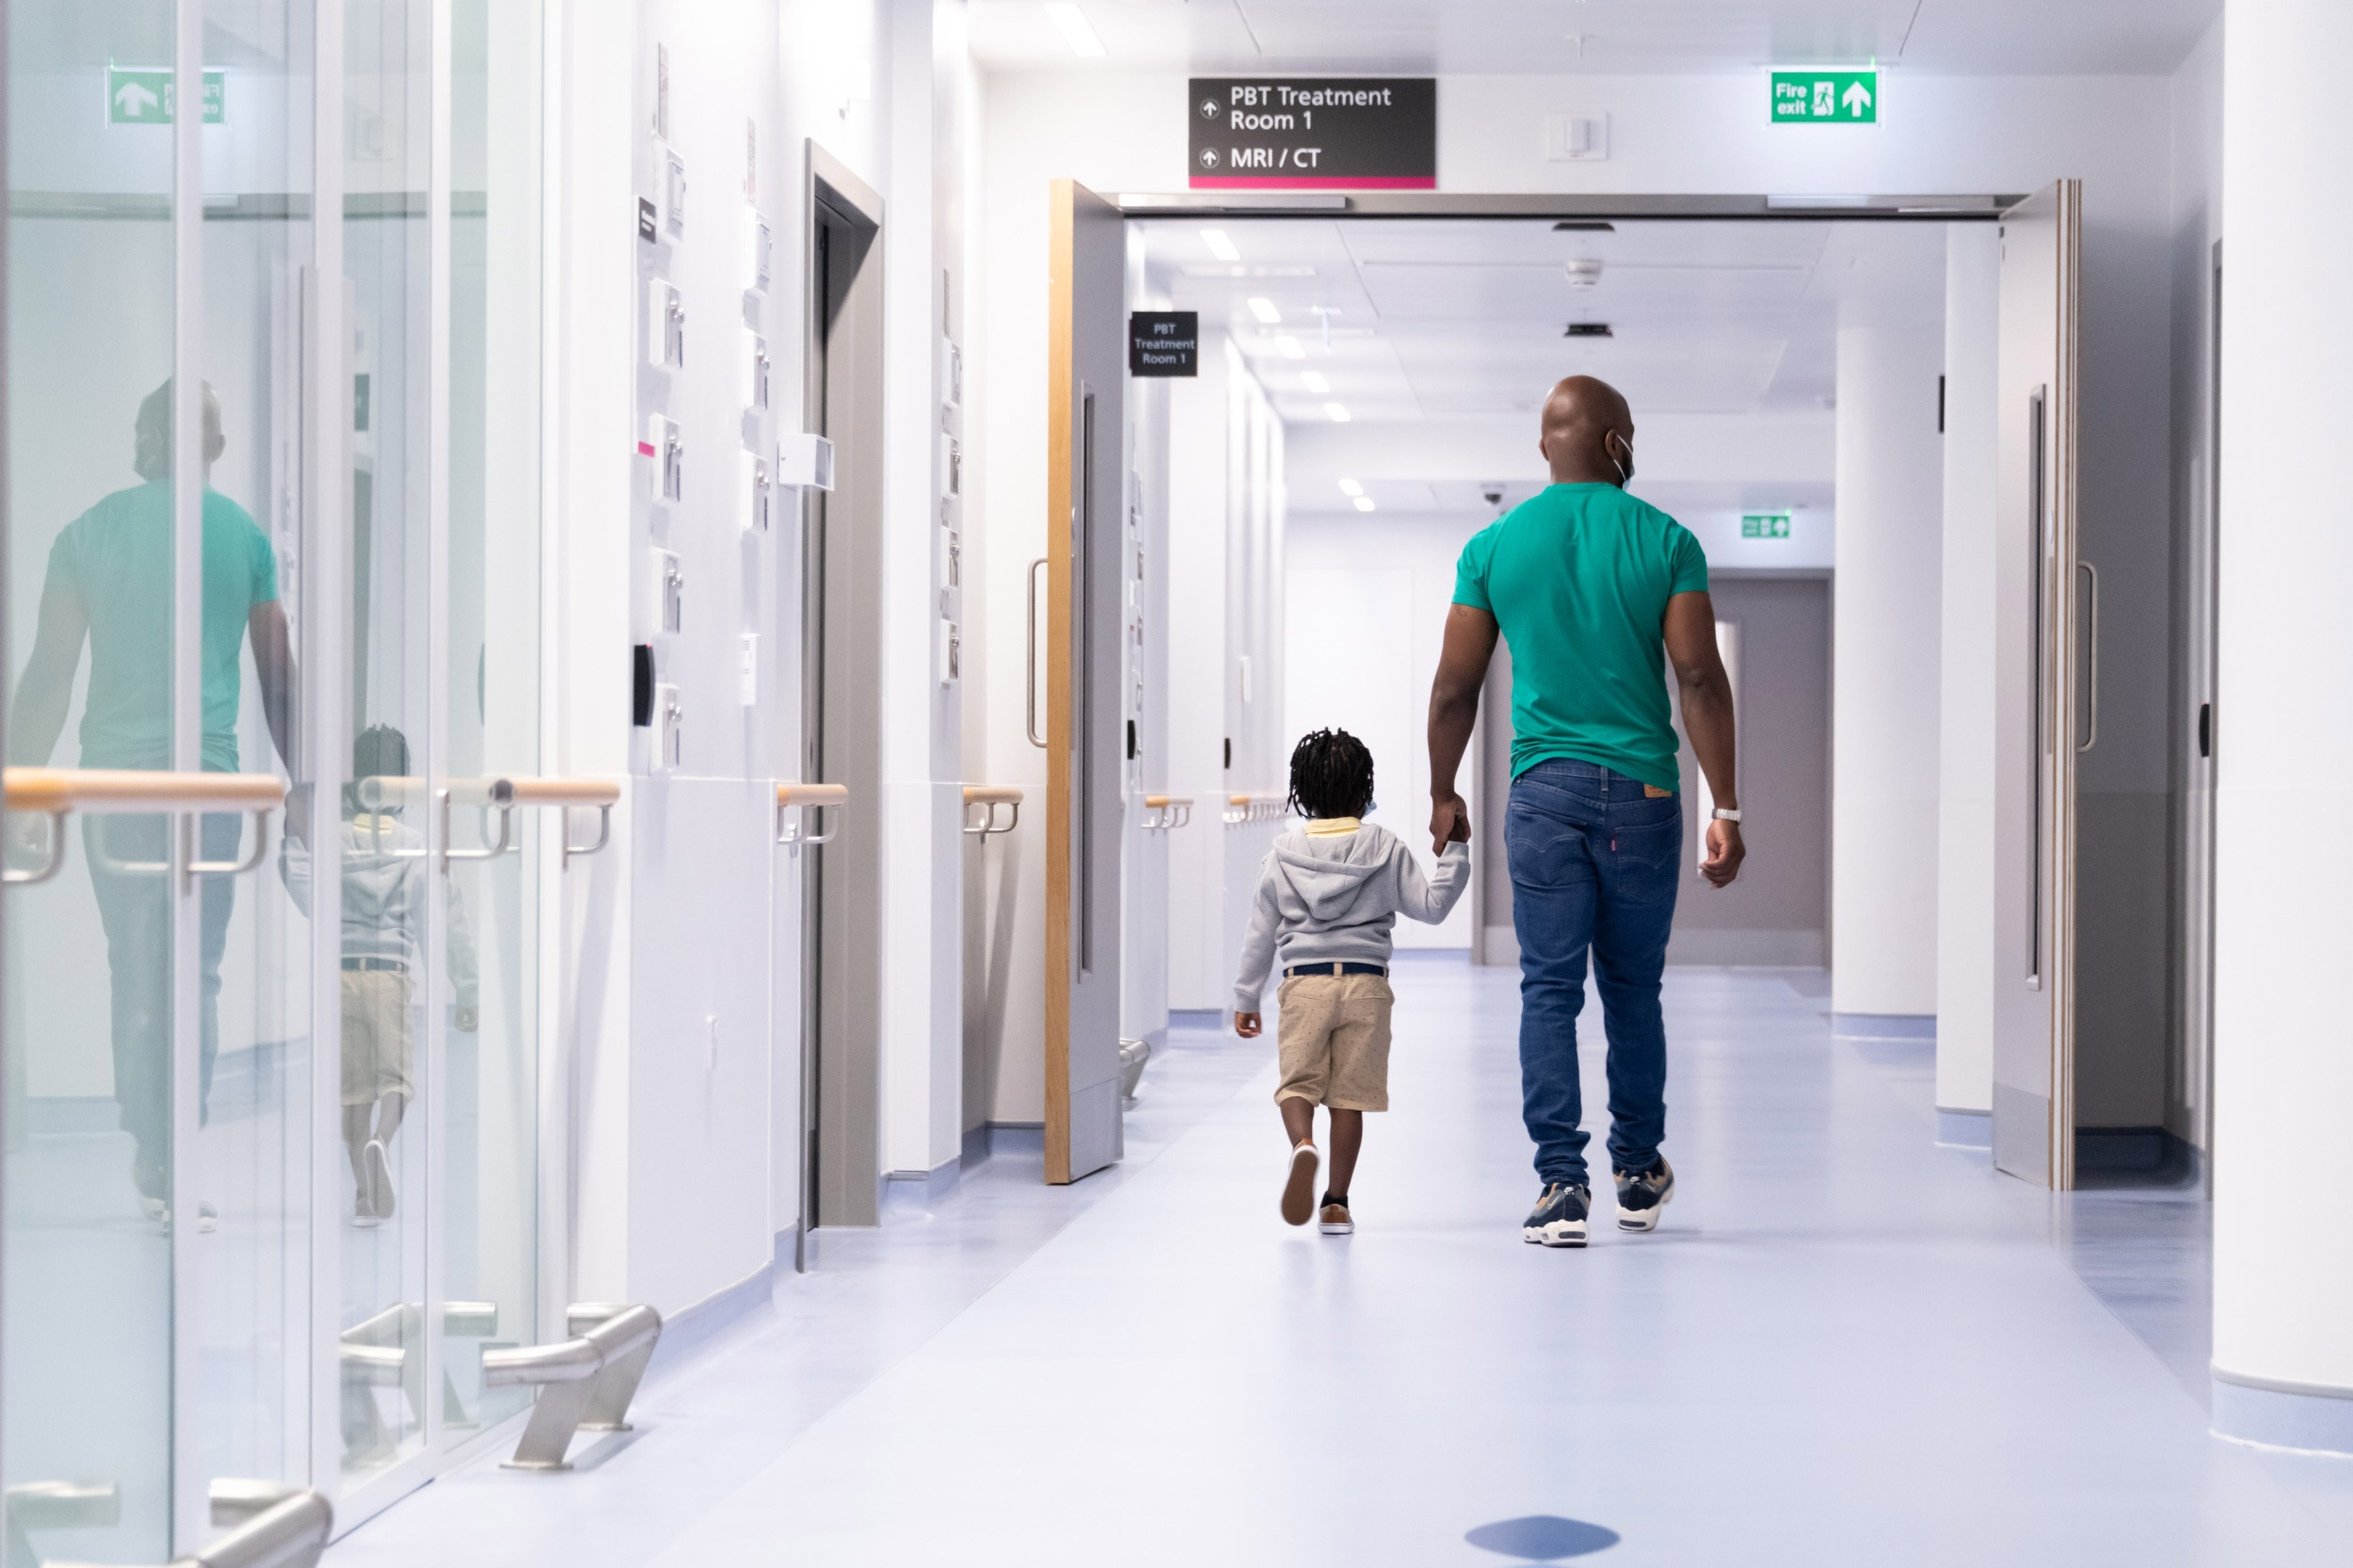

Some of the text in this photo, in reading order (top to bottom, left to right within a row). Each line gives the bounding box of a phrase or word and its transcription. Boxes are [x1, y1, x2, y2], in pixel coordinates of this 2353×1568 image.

[1231, 87, 1392, 106] PBT Treatment
[1776, 83, 1808, 99] Fire
[1777, 99, 1807, 115] exit
[1231, 110, 1312, 130] Room 1
[1231, 148, 1322, 168] MRI / CT
[1154, 323, 1176, 335] PBT
[1134, 338, 1195, 350] Treatment
[1143, 353, 1187, 365] Room 1
